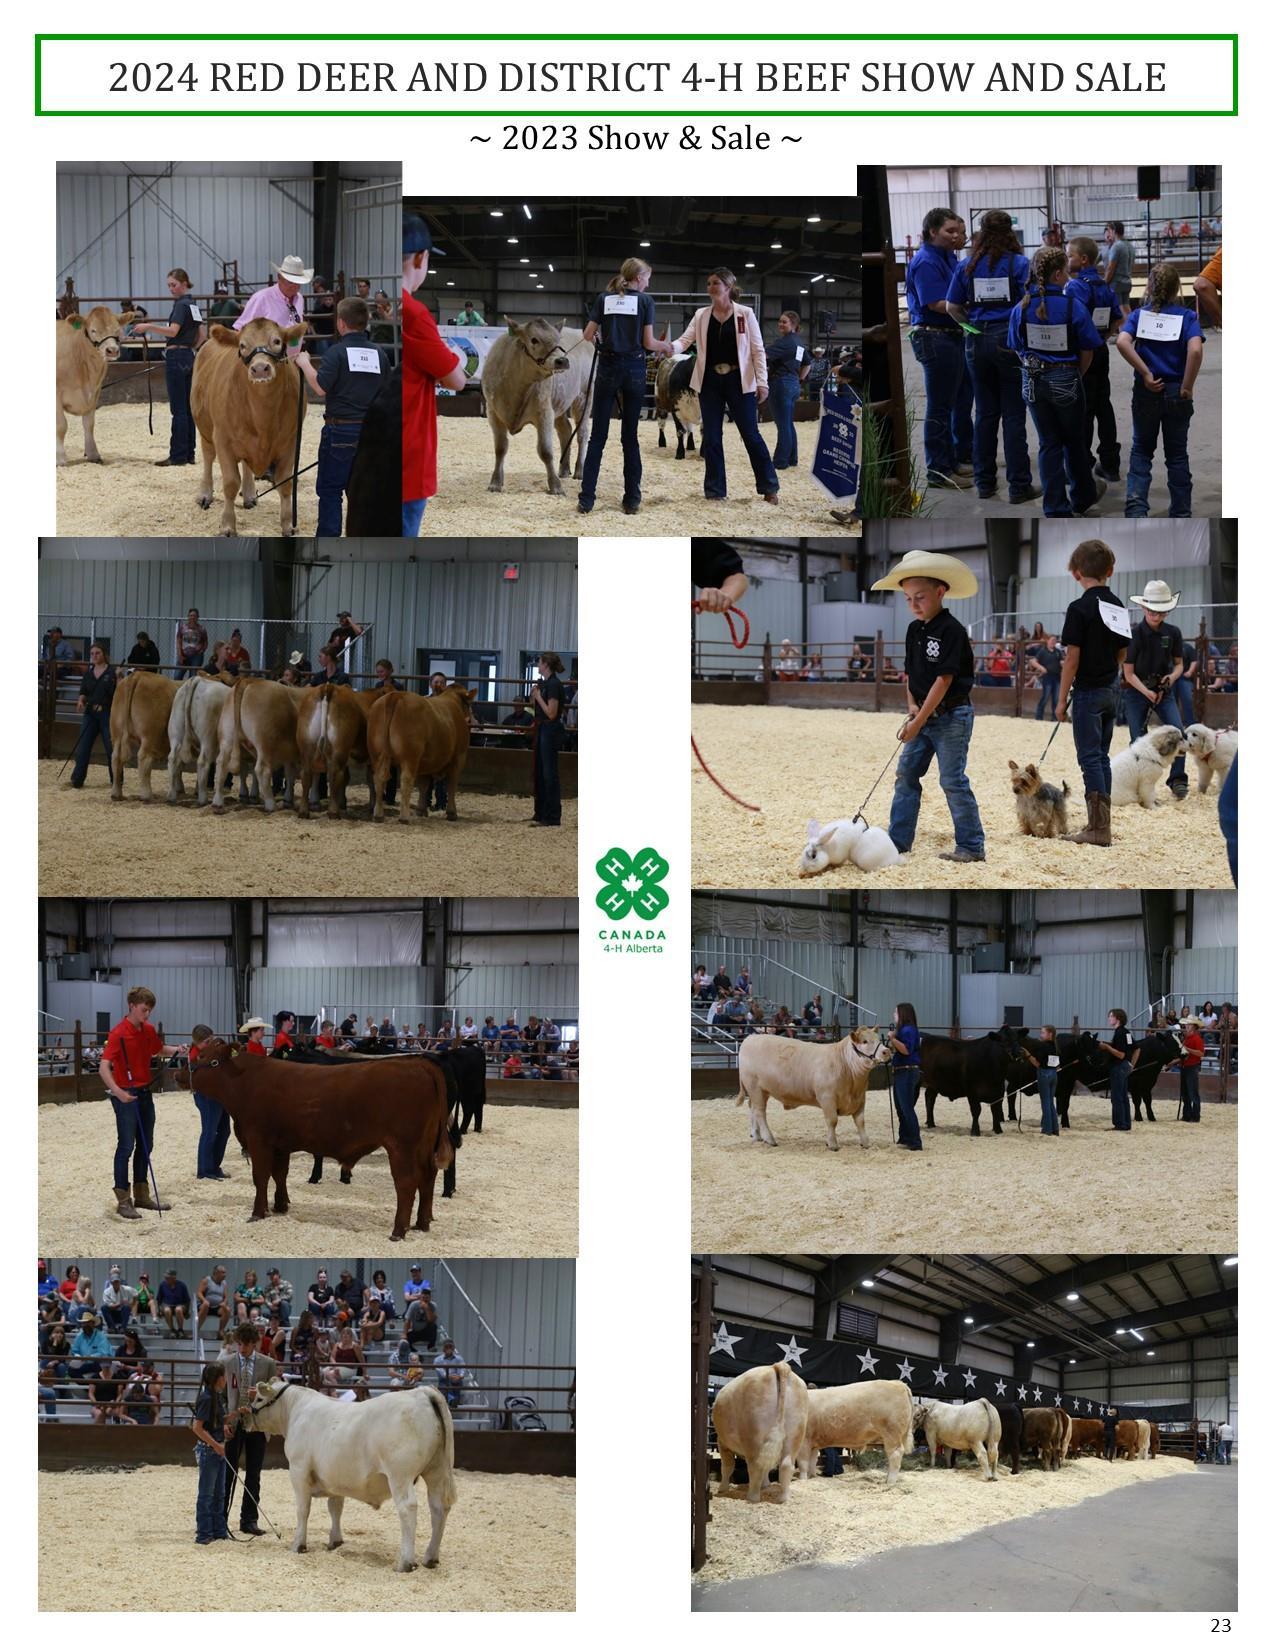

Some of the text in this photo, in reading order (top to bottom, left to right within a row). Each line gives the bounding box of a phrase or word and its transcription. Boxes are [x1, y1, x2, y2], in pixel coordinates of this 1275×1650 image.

[110, 63, 1165, 92] 2024 RED DEER AND DISTRICT 4-H BEEF SHOW AND SALE
[503, 126, 577, 150] 2023
[589, 125, 669, 150] Show
[680, 126, 702, 150] &
[712, 125, 770, 150] Sale
[599, 930, 666, 940] CANADA
[604, 944, 663, 953] 4-H Alberta
[1211, 1618, 1231, 1632] 23
